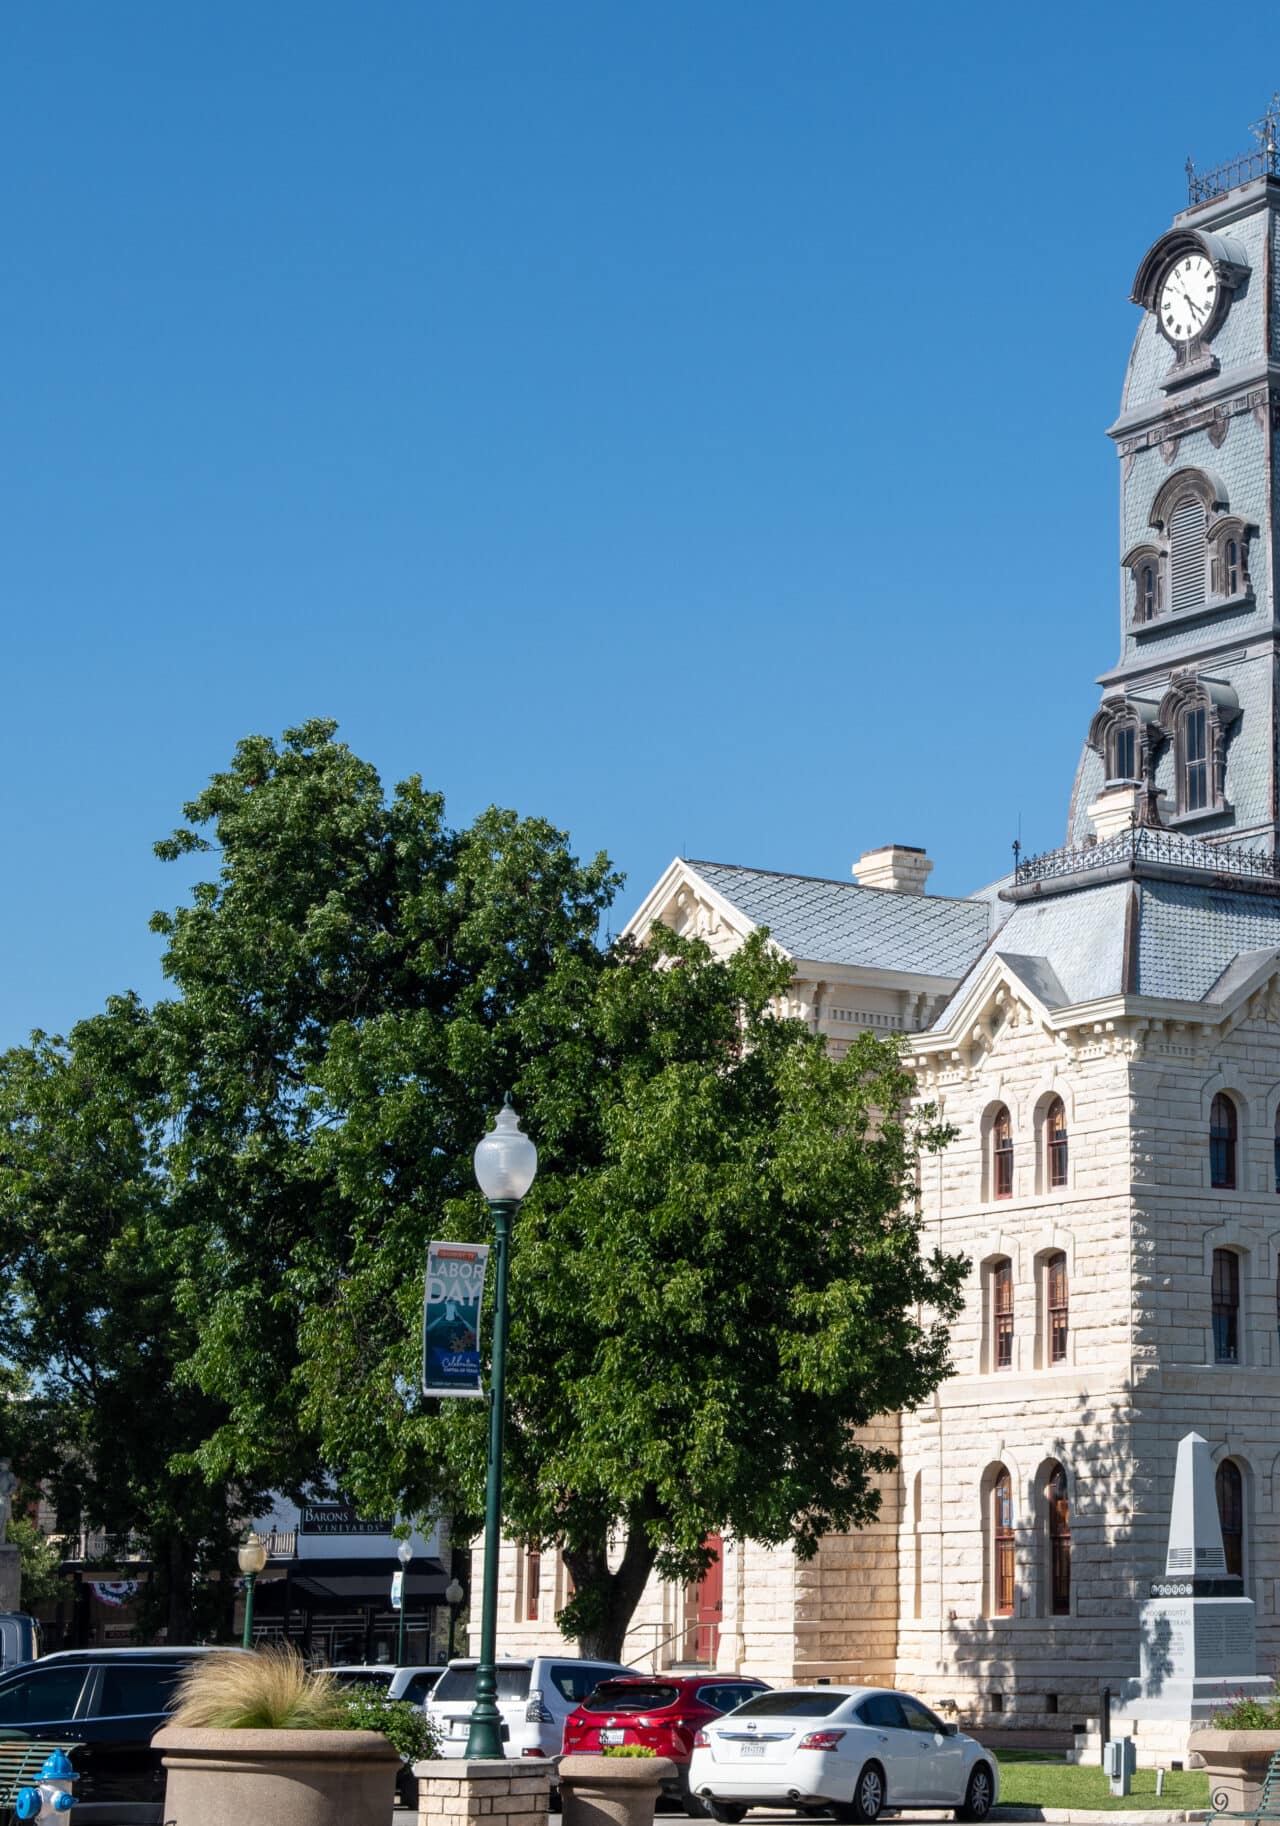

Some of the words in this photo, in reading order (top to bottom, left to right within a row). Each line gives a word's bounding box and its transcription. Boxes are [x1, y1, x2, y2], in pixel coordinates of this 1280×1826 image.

[429, 1261, 484, 1279] LABOR
[426, 1279, 482, 1306] DAY
[317, 1523, 380, 1532] VINEYARDS
